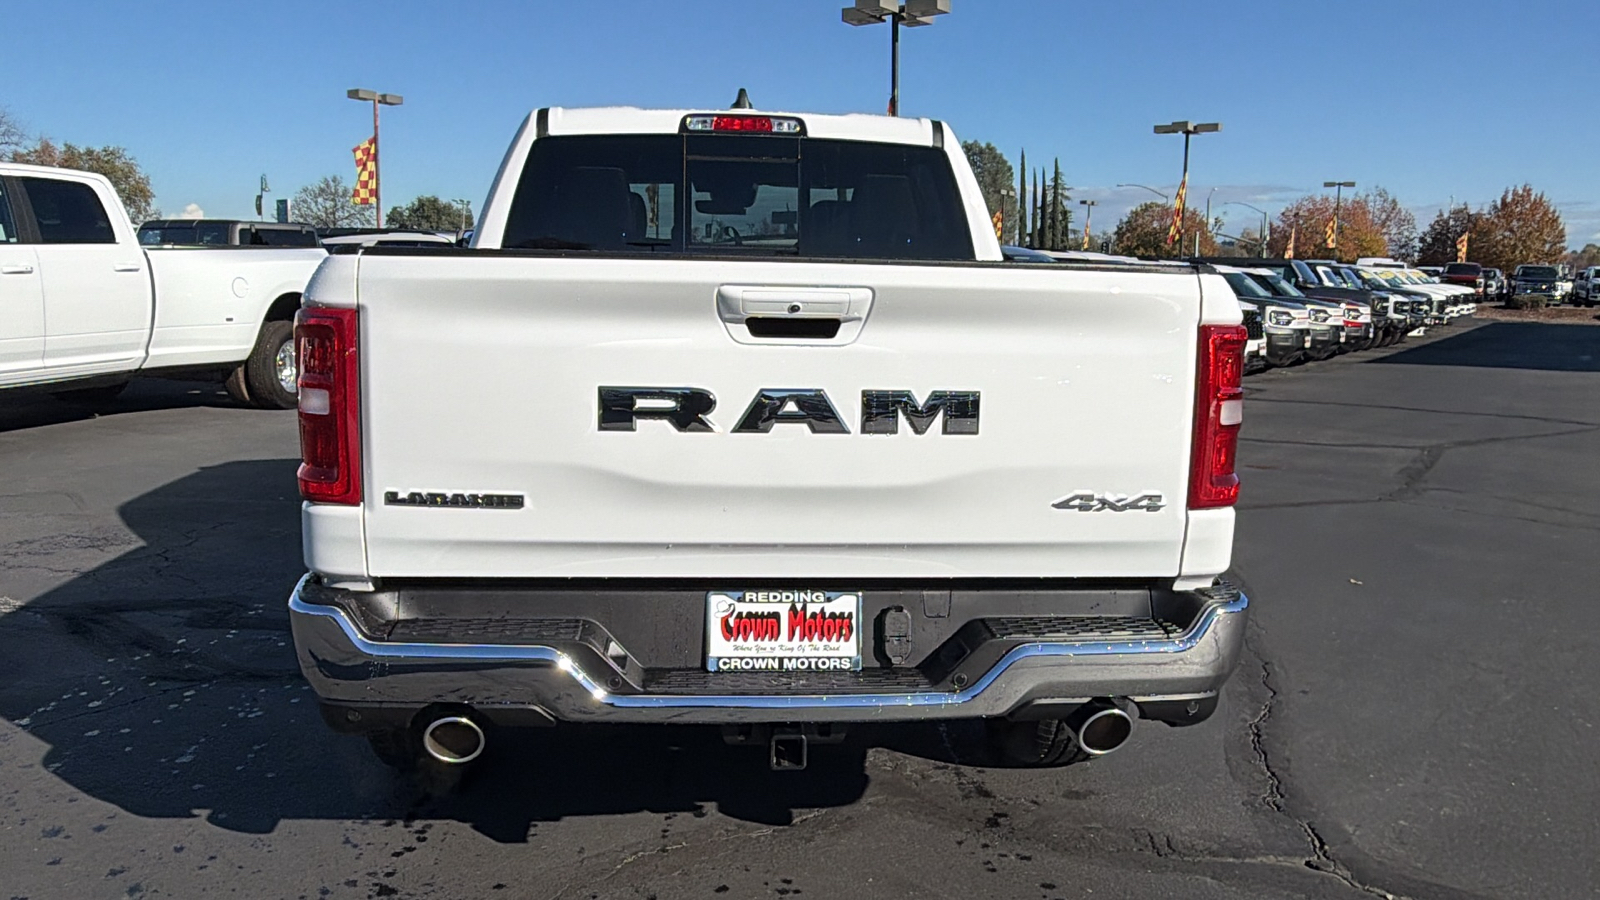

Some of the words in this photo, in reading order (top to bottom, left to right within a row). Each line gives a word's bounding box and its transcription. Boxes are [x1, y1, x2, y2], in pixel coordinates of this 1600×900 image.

[597, 385, 981, 435] RAM
[384, 490, 525, 509] LARAMIE
[745, 592, 825, 602] REDDING
[721, 611, 781, 642] Crown
[788, 605, 853, 642] Motors
[754, 644, 776, 653] Youre
[778, 644, 795, 652] King
[797, 644, 806, 652] Of
[808, 644, 820, 652] The
[718, 658, 779, 669] CROWN
[783, 658, 851, 669] MOTORS
